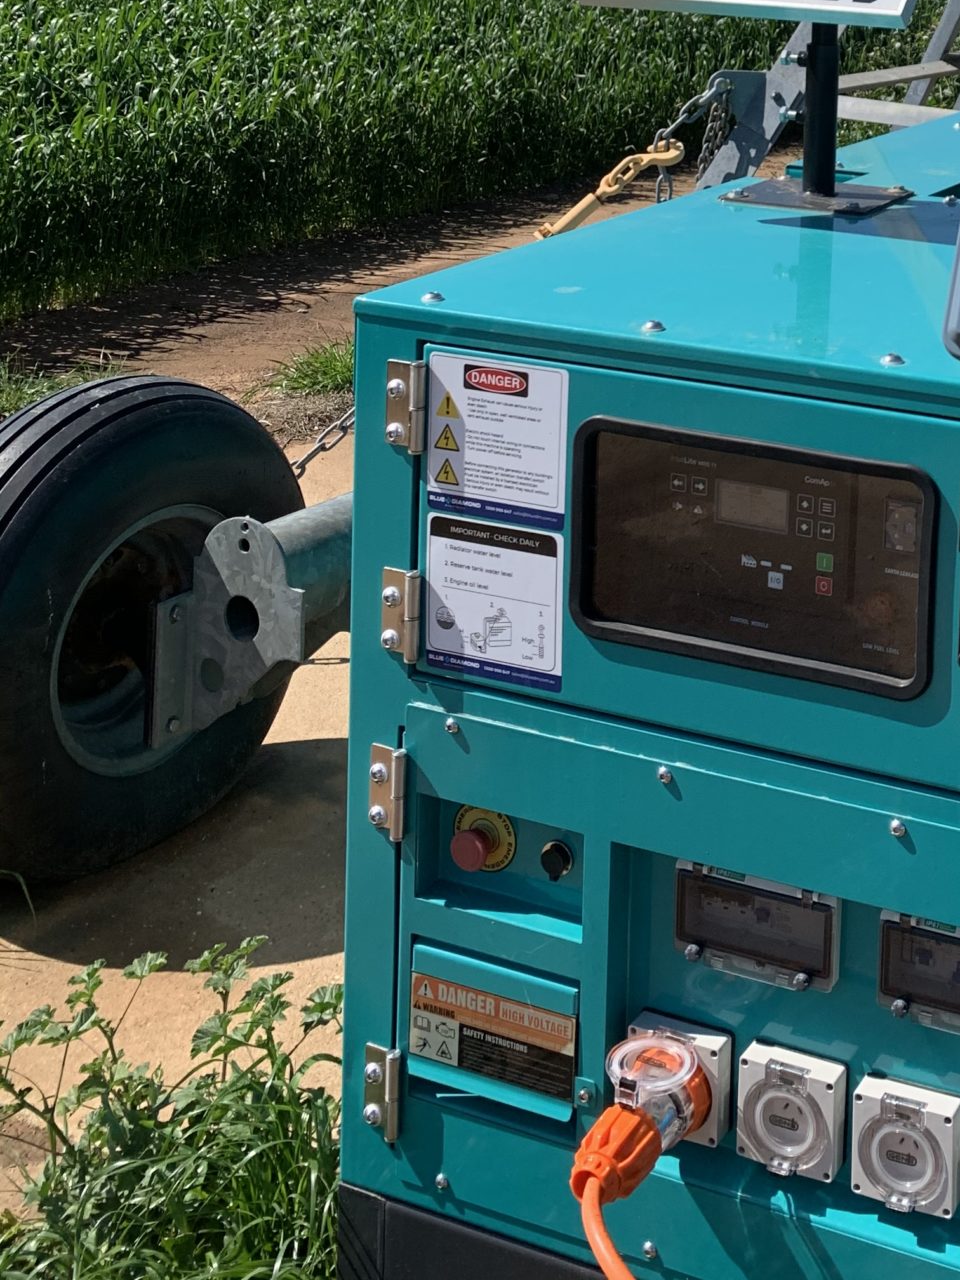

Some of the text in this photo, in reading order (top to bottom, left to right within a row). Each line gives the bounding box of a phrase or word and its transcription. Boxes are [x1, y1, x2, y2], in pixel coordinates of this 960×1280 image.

[471, 372, 520, 389] DANGER
[804, 475, 830, 487] ComAp
[450, 525, 540, 547] IMPORTANT CHECK DAILY
[497, 812, 513, 837] STOP
[422, 1002, 455, 1019] WARNING
[437, 983, 495, 1016] DANGER
[501, 1008, 569, 1036] HIGH VOLTAGE
[463, 1027, 528, 1054] SAFETY INSTRUCTIONS
